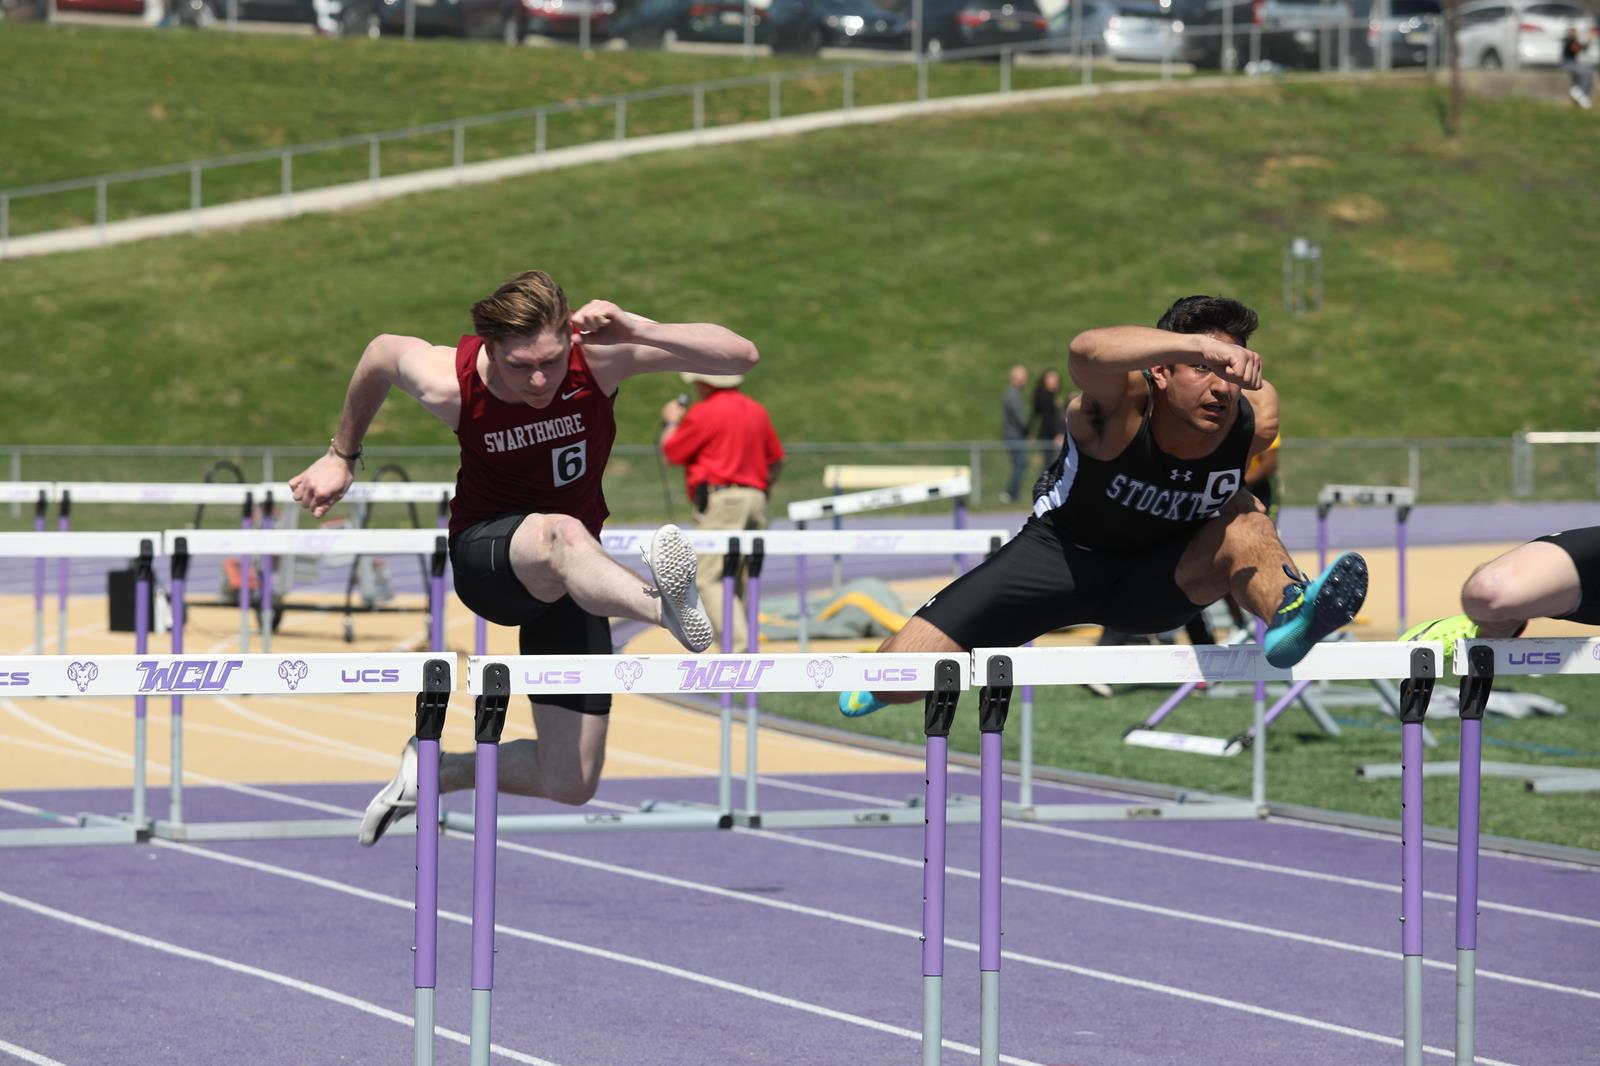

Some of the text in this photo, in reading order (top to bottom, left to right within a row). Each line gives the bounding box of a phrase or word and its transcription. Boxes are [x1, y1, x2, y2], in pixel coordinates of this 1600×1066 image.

[484, 413, 586, 453] SWARTHMORE
[557, 446, 583, 482] 6
[1106, 474, 1217, 522] STOCKT
[524, 659, 917, 690] UCS WCU UCS
[1508, 652, 1561, 665] UCS
[135, 660, 243, 692] WCU
[341, 668, 399, 684] UCS
